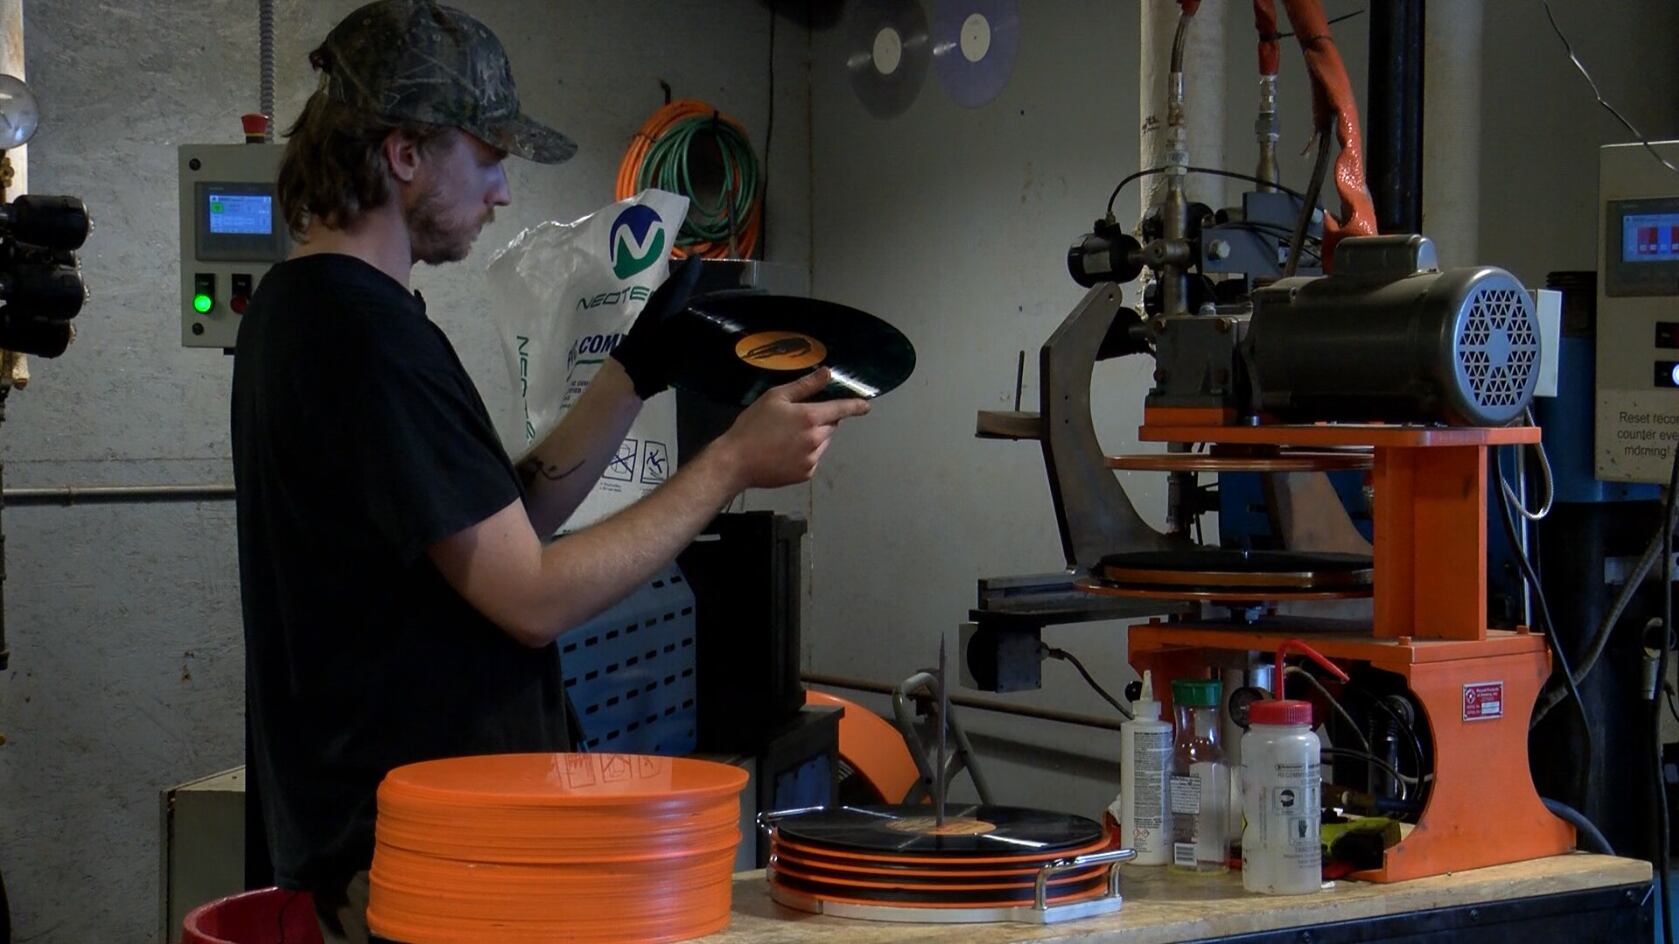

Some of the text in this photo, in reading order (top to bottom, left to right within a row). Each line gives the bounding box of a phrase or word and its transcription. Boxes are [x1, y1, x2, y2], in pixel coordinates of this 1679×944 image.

[576, 286, 654, 312] NEOTE
[579, 333, 624, 355] COM
[1619, 411, 1650, 424] Reset
[1617, 429, 1656, 441] counter
[1624, 445, 1670, 460] morning!
